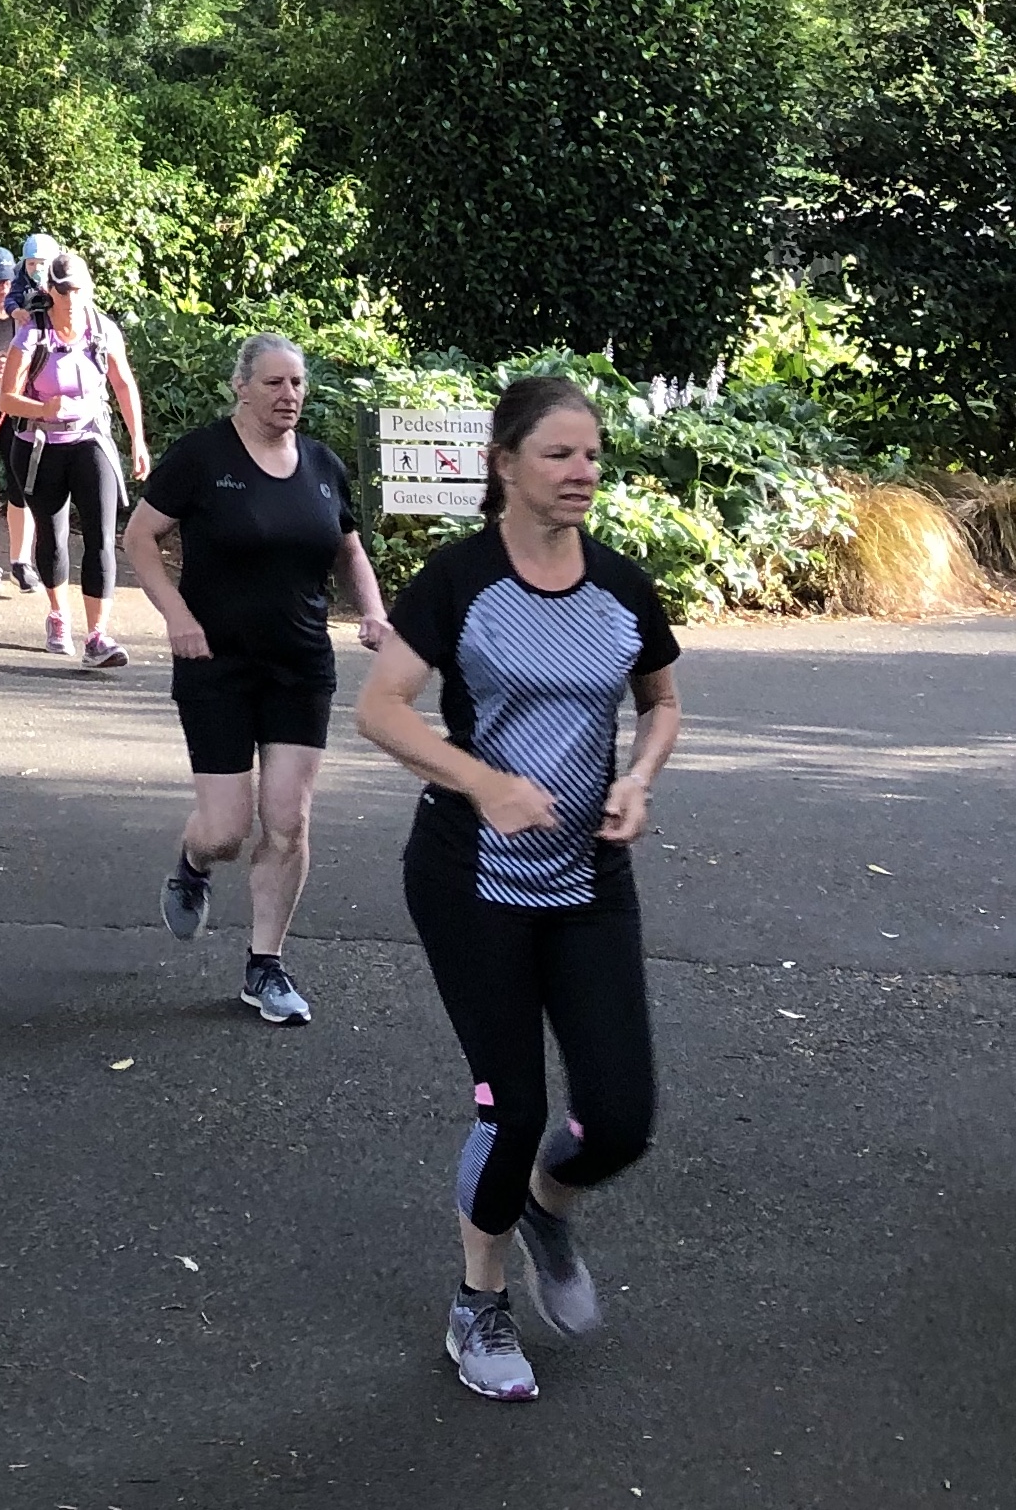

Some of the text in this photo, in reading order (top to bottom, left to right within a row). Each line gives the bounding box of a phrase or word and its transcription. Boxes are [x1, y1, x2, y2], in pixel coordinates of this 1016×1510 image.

[392, 415, 492, 434] Pedestrians
[393, 490, 433, 504] Gates
[437, 491, 477, 505] Close
